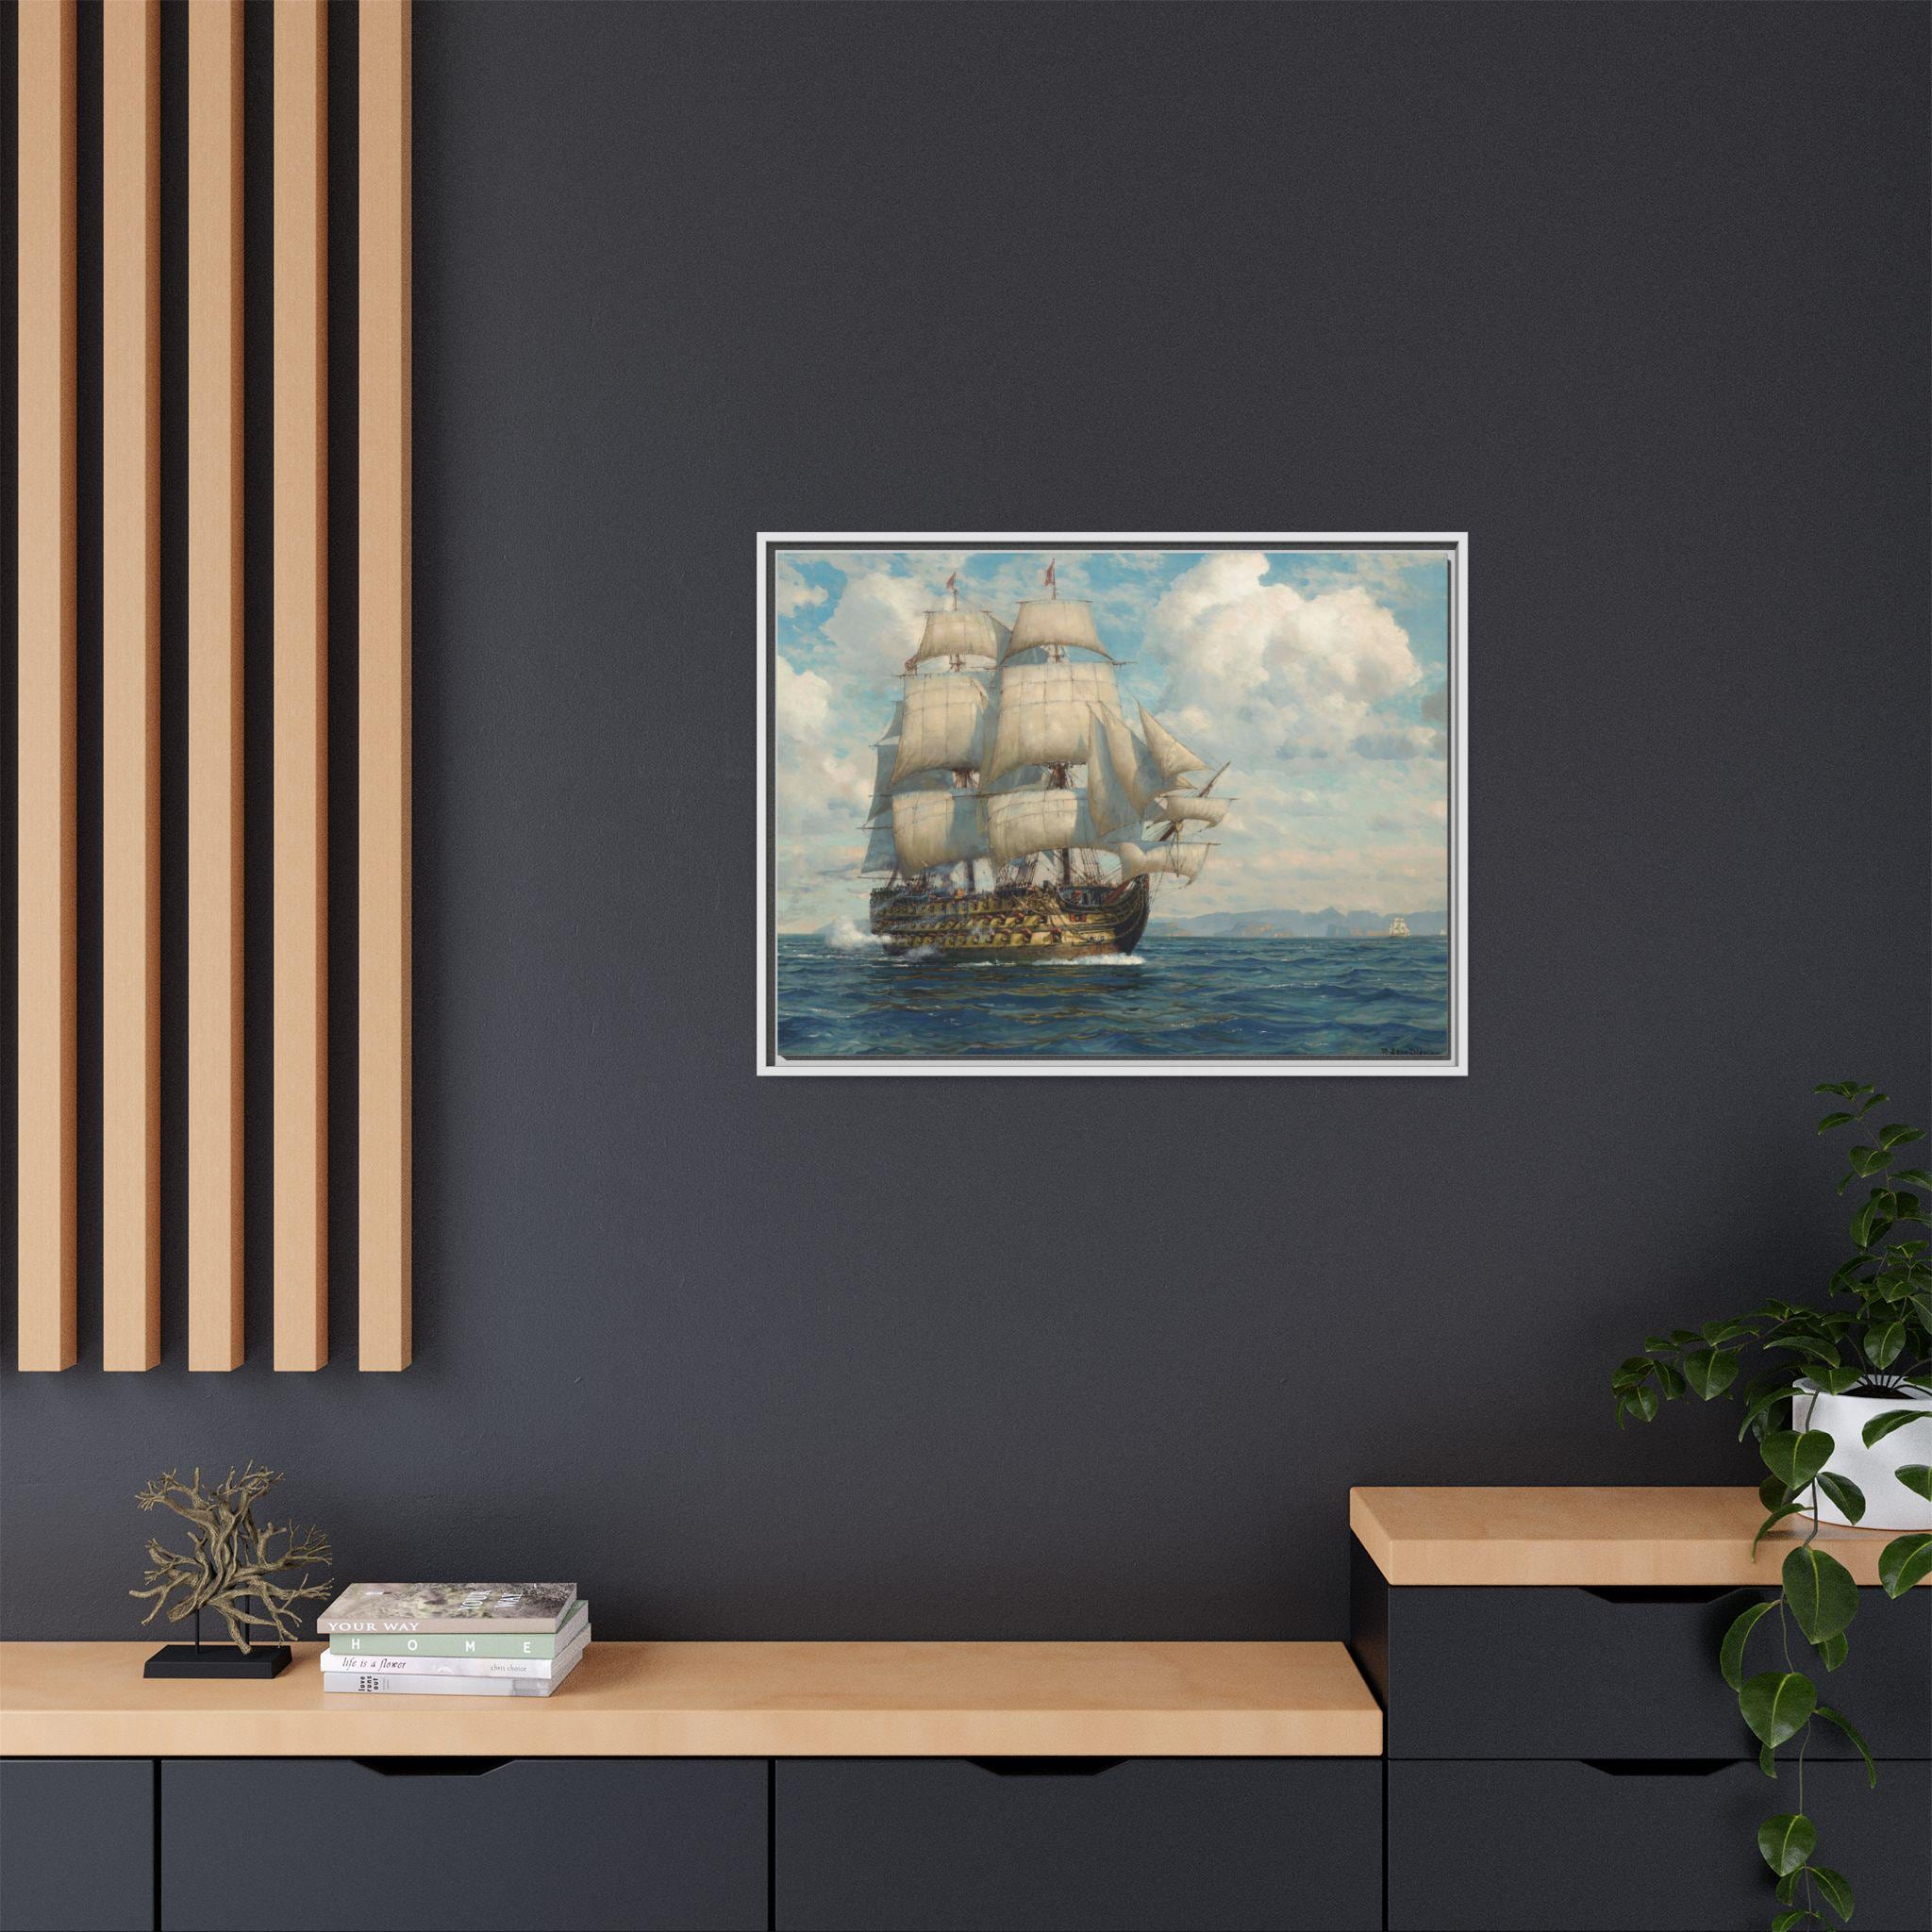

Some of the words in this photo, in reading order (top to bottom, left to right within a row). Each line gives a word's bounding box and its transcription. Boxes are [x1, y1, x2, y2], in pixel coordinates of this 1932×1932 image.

[327, 1622, 377, 1632] YOUR
[384, 1623, 421, 1631] WAY
[342, 1657, 358, 1671] life
[360, 1658, 367, 1668] is
[378, 1658, 407, 1672] flower
[491, 1663, 505, 1672] chris
